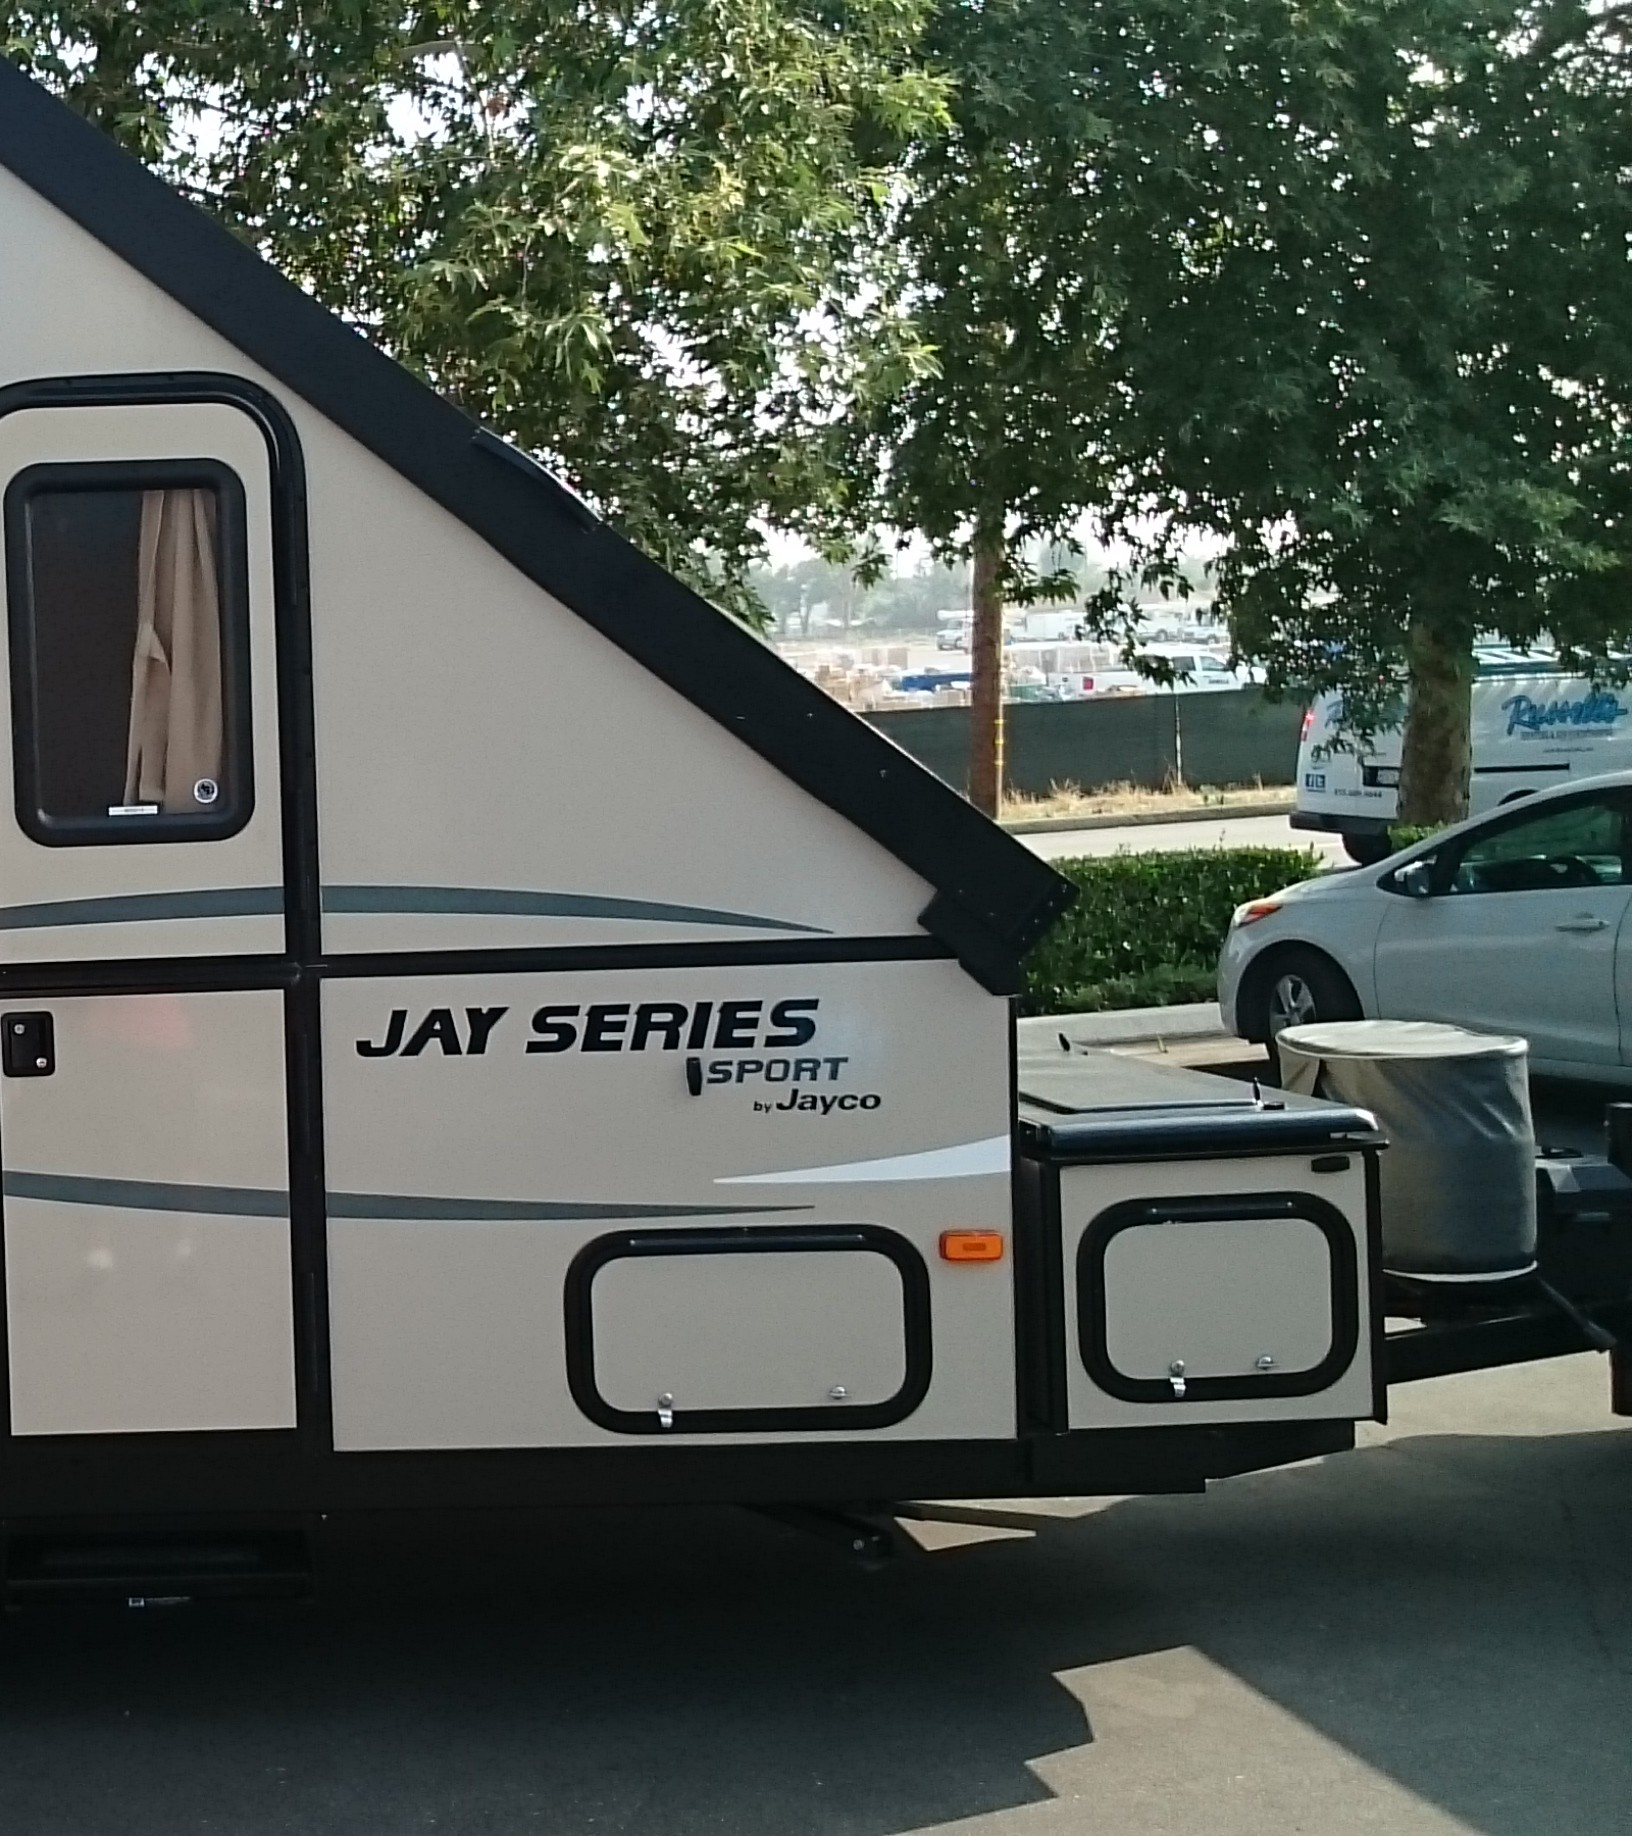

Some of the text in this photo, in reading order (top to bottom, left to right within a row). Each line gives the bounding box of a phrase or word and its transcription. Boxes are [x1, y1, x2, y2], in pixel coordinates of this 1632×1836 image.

[355, 998, 820, 1057] JAY SERIES
[706, 1056, 849, 1084] SPORT
[753, 1088, 882, 1116] by Jayco
